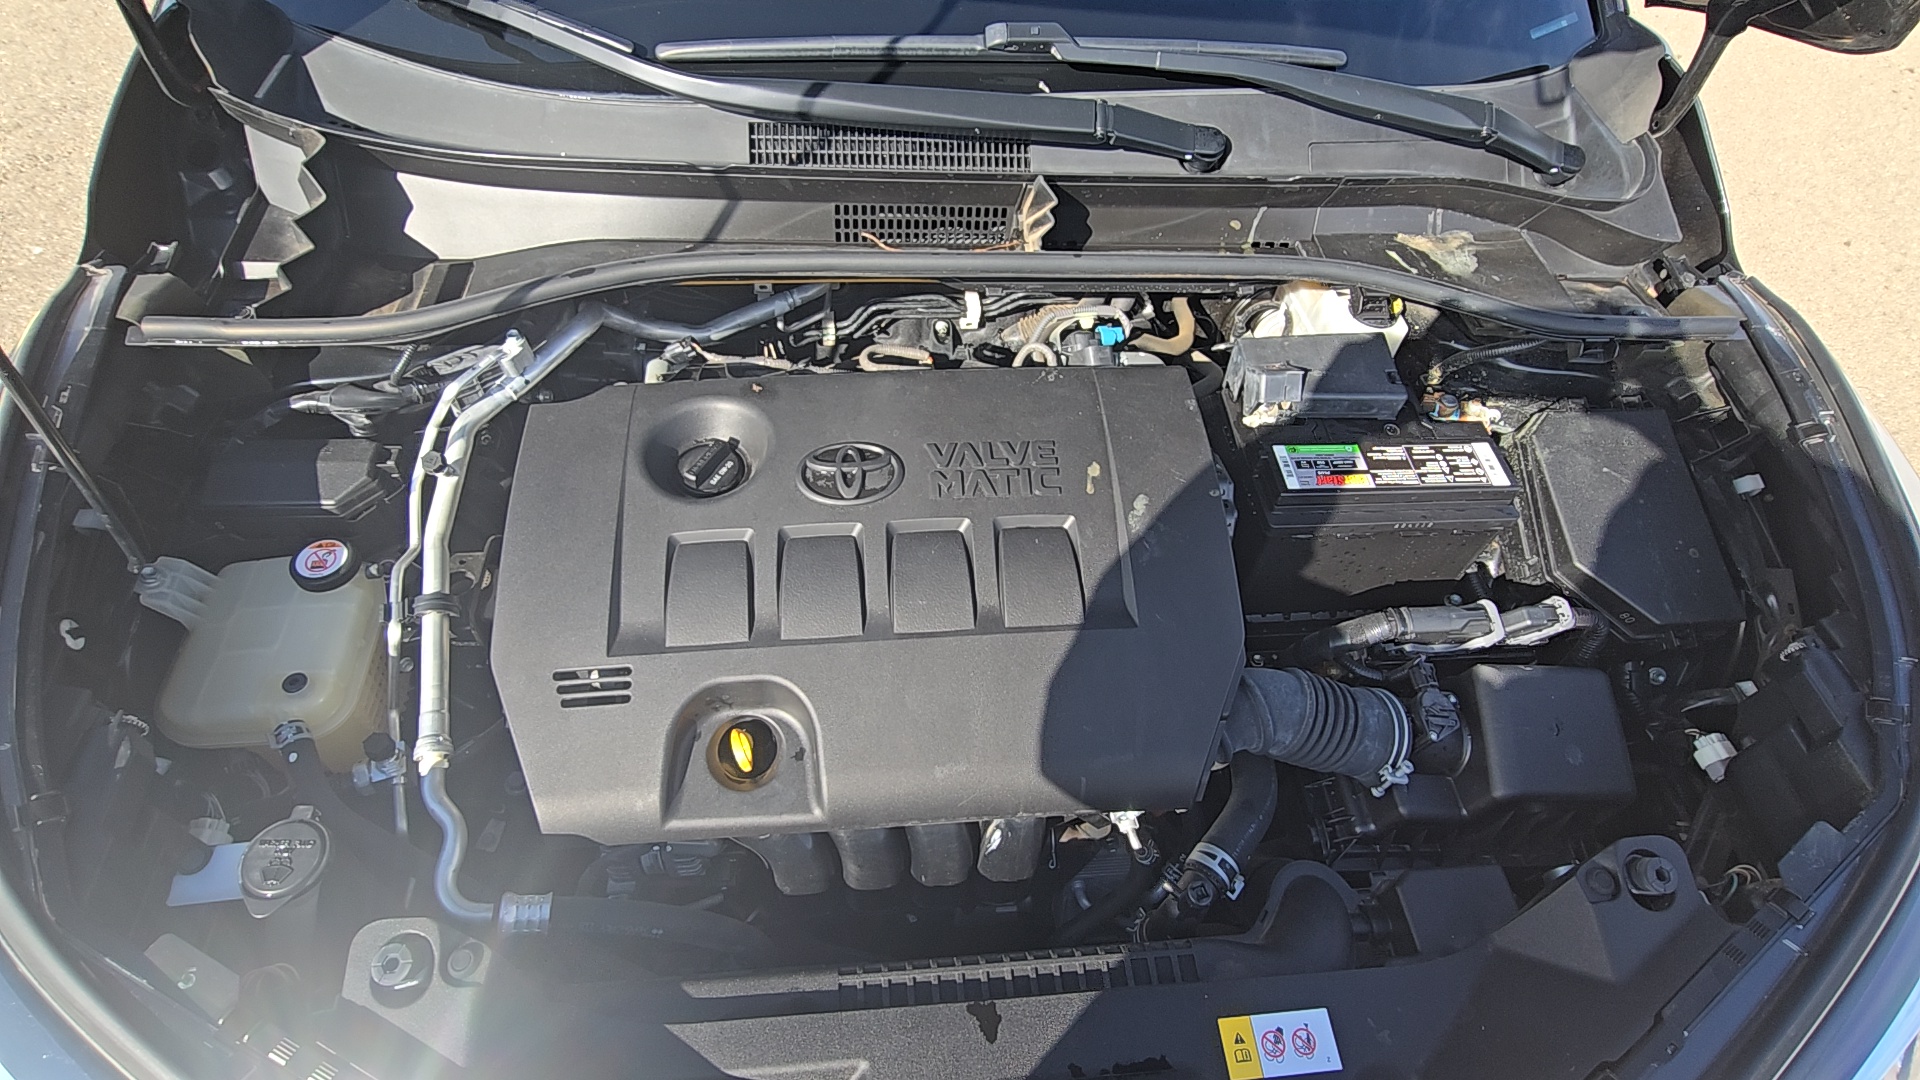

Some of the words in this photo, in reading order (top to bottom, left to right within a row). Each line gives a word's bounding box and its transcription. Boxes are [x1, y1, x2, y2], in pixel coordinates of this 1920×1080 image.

[925, 440, 1058, 467] VALVE
[709, 474, 721, 485] SAE
[929, 467, 1062, 498] MATIC
[1316, 474, 1370, 486] Start
[1619, 612, 1636, 624] 80
